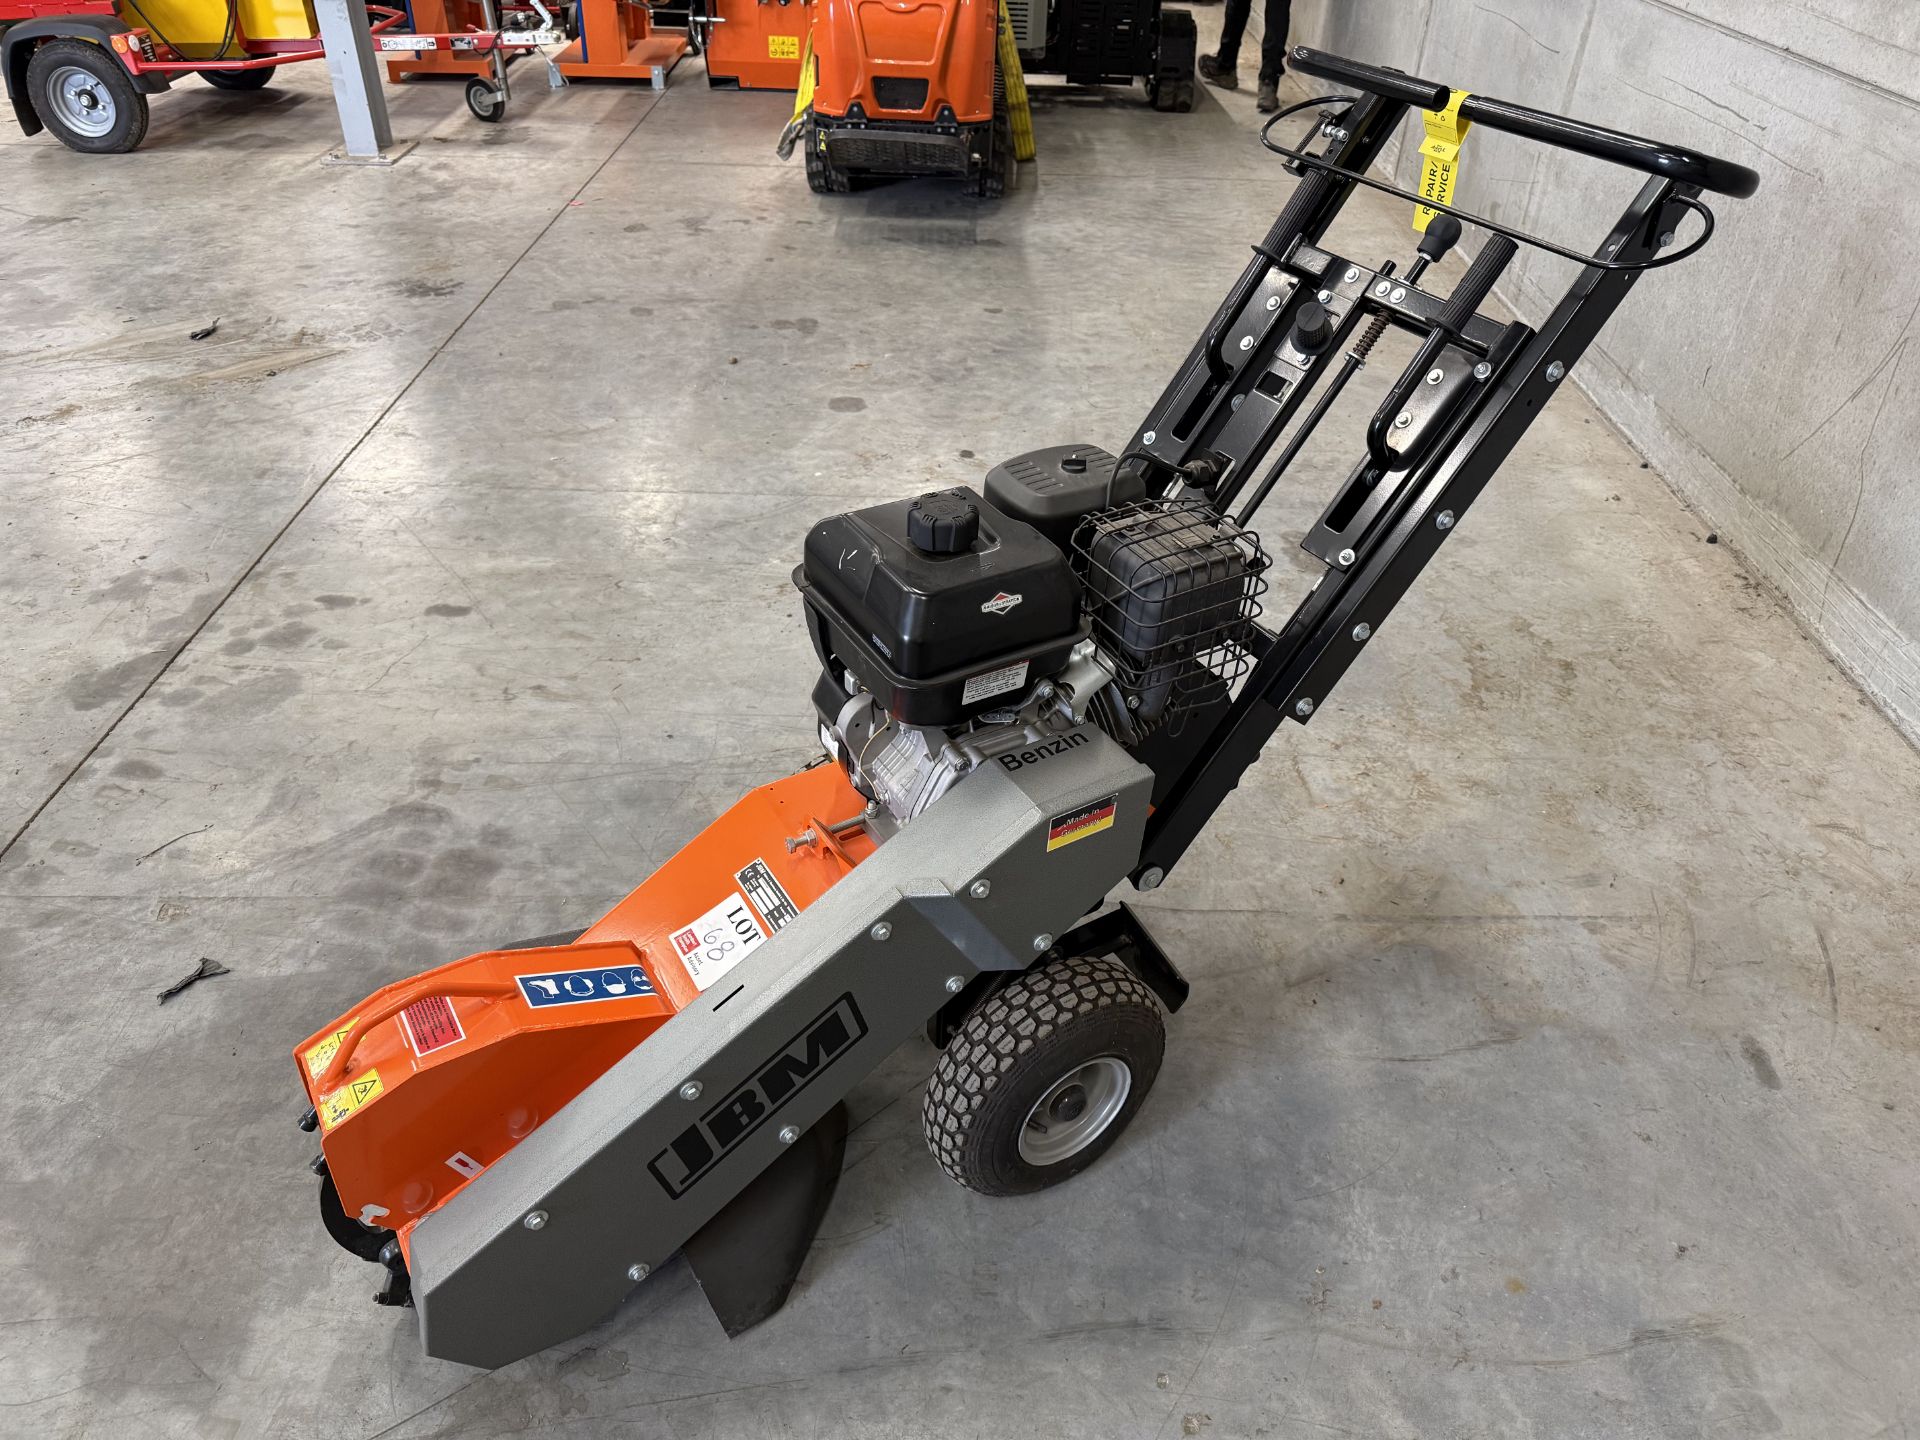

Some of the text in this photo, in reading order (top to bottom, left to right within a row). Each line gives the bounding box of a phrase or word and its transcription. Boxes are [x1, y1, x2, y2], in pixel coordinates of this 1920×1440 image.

[1422, 161, 1438, 215] RPAIR/
[1434, 164, 1451, 218] SRVICE
[998, 732, 1089, 772] Benzin
[1063, 813, 1089, 827] Made
[703, 928, 735, 962] 68
[727, 905, 761, 945] LOT
[669, 1010, 851, 1187] JBM
